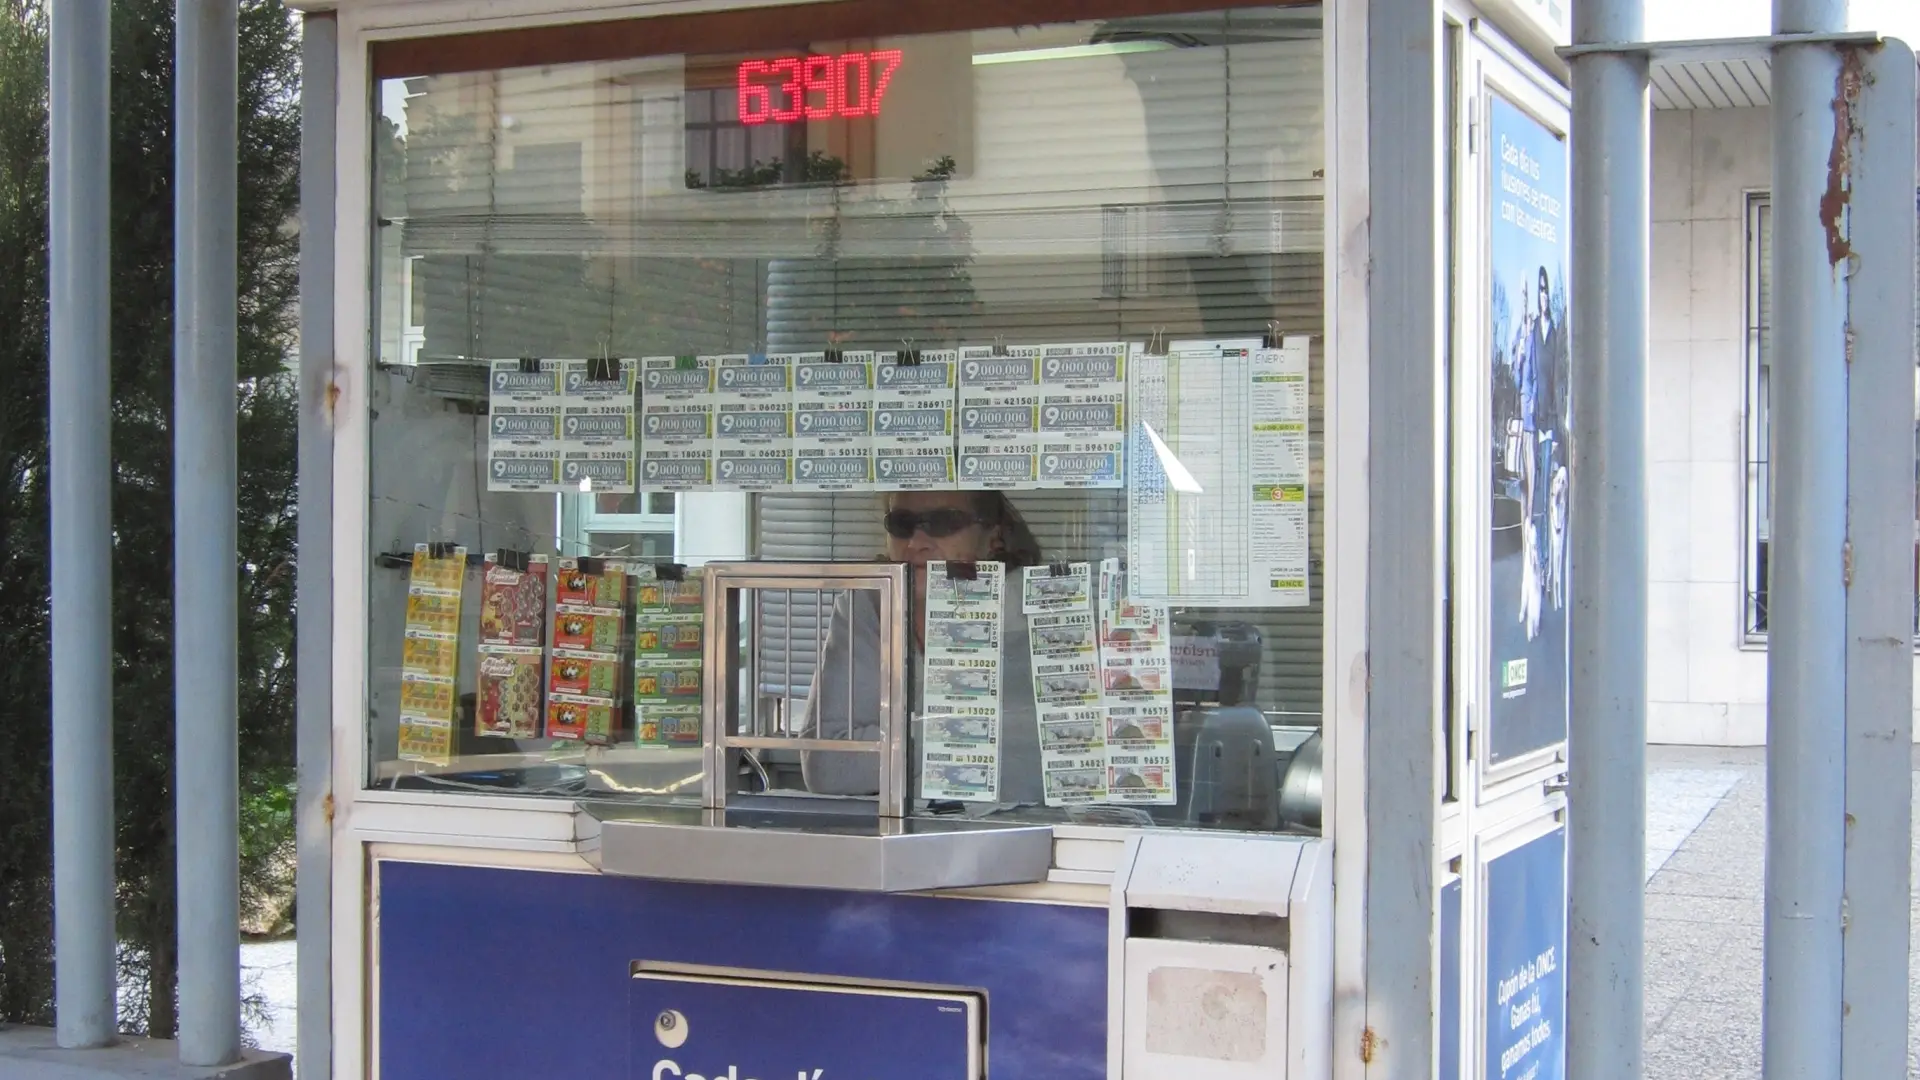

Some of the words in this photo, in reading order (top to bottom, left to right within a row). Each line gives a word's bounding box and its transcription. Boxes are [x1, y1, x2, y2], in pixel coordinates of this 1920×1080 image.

[737, 50, 903, 124] 63907
[764, 357, 786, 365] 6023
[843, 355, 866, 363] 0132
[1255, 353, 1285, 365] ENERO
[838, 401, 868, 409] 50132
[917, 401, 945, 409] 28691
[1004, 397, 1032, 405] 42150
[759, 403, 787, 411] 06023
[838, 448, 868, 456] 50132
[1003, 445, 1032, 453] 42150
[759, 450, 787, 458] 06023
[975, 564, 999, 572] 3020
[970, 611, 998, 619] 13020
[969, 660, 997, 668] 13020
[1509, 662, 1526, 682] ONCE
[968, 707, 996, 716] 13020
[966, 755, 995, 763] 13020
[1519, 964, 1528, 991] de
[1528, 959, 1535, 984] la
[1510, 999, 1530, 1030] Ganas
[1501, 1033, 1531, 1079] ganamos
